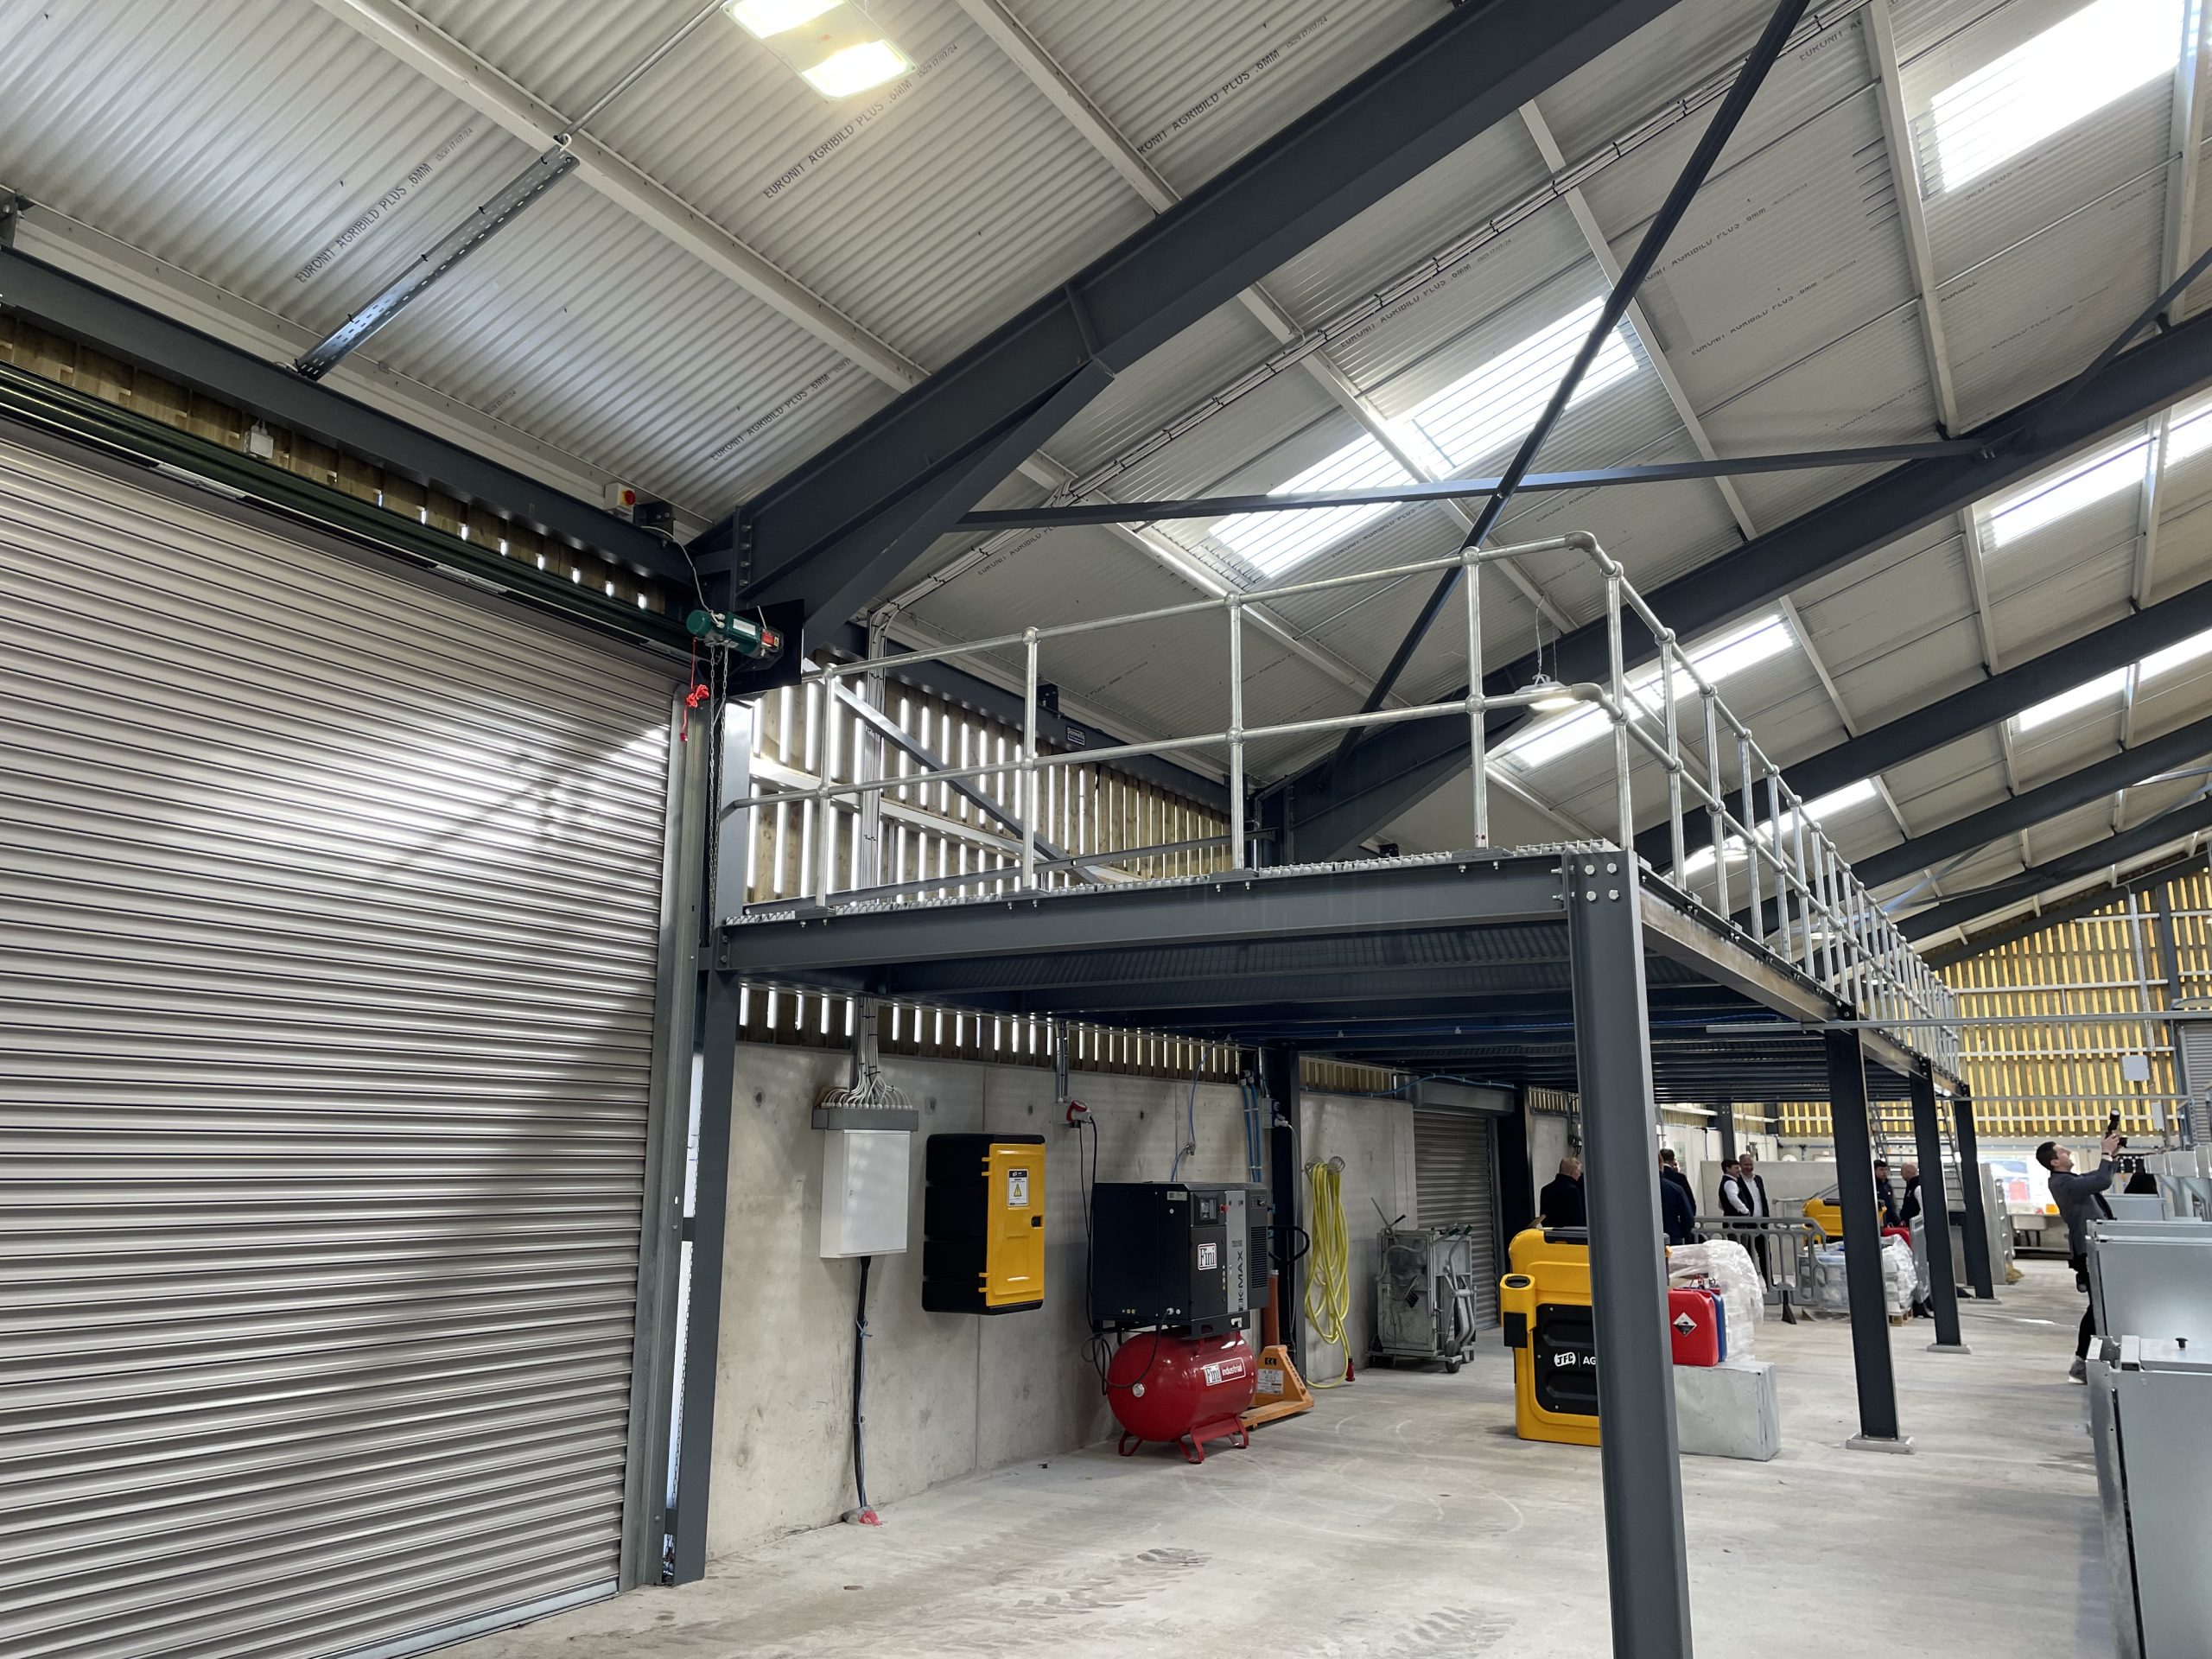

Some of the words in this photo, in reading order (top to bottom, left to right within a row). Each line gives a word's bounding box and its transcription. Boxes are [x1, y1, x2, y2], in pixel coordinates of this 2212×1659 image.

[1137, 130, 1167, 156] RONIT
[1171, 92, 1220, 132] AGRIBILD
[1221, 69, 1251, 95] PLUS
[1255, 48, 1281, 73] .6MM
[762, 162, 806, 200] EURONIT
[807, 124, 855, 166] AGRIBILD
[855, 102, 885, 127] PLUS
[888, 78, 913, 105] .6MM
[294, 247, 336, 283] EURONIT
[334, 208, 380, 250] AGRIBILD
[378, 185, 408, 212] PLUS
[408, 162, 434, 188] .6MM
[710, 434, 746, 461] EURONIT
[746, 406, 785, 437] AGRIBILD
[785, 389, 809, 410] PLUS
[1199, 1247, 1216, 1266] Fini
[1205, 1364, 1220, 1383] Fini
[1221, 1363, 1243, 1376] industrial
[1556, 1353, 1574, 1365] JFC
[1582, 1356, 1597, 1365] AG
